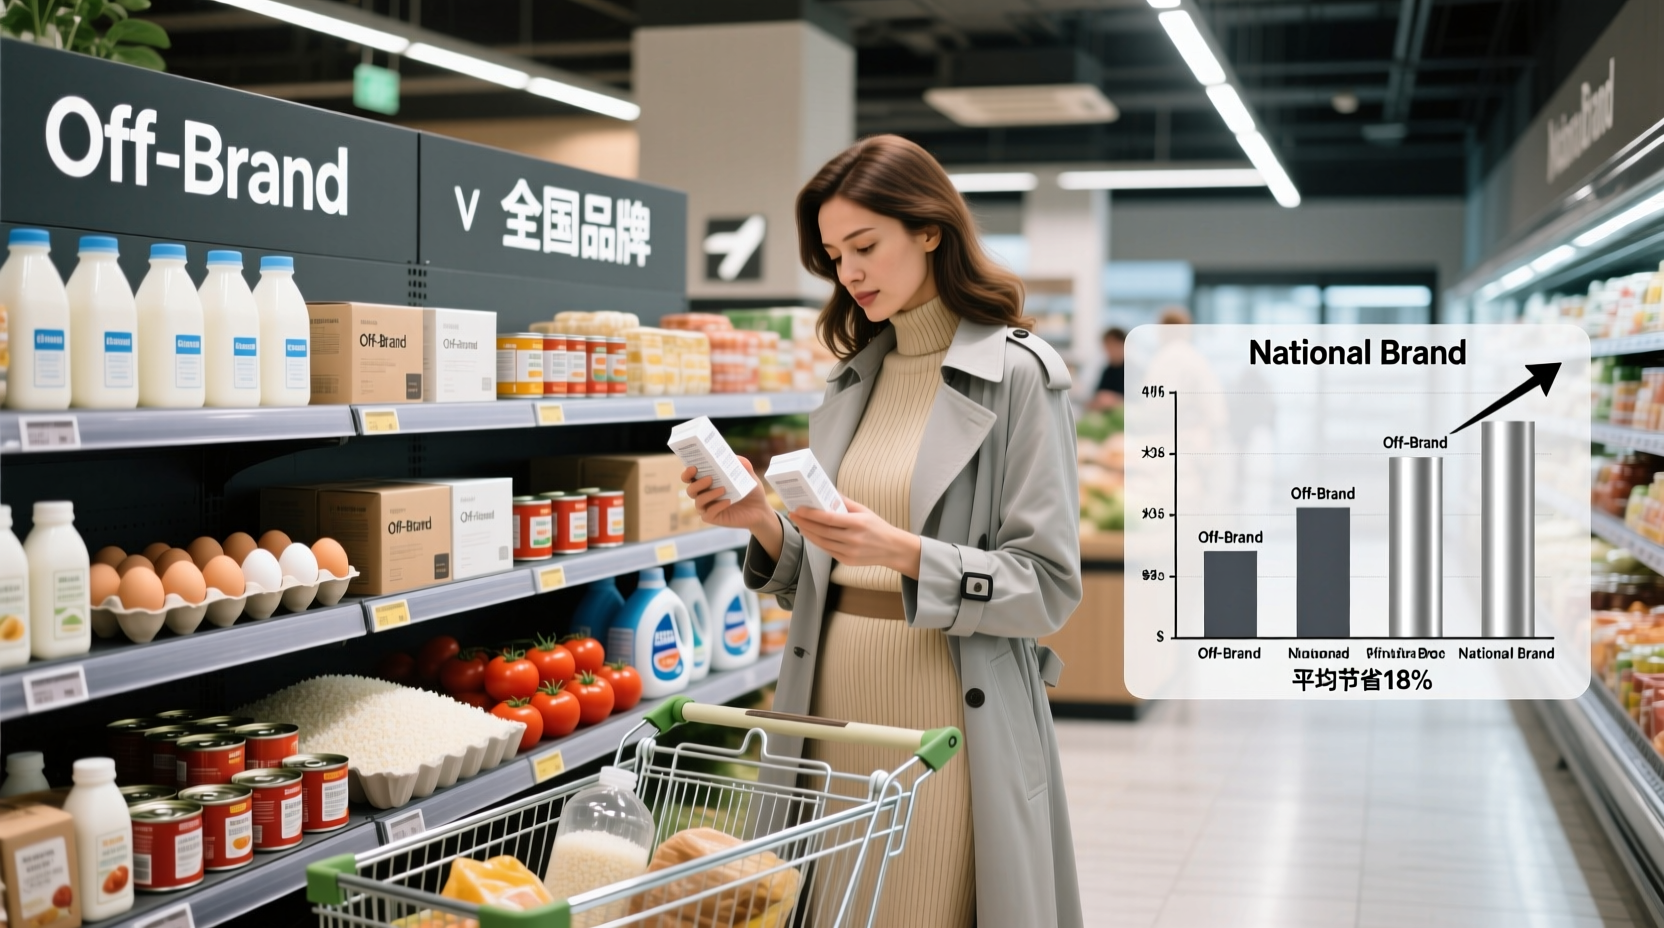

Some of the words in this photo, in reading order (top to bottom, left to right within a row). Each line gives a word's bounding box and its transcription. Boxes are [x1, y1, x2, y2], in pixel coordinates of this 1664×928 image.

[45, 95, 348, 216] Off-Brand
[501, 178, 652, 268] 全国品牌
